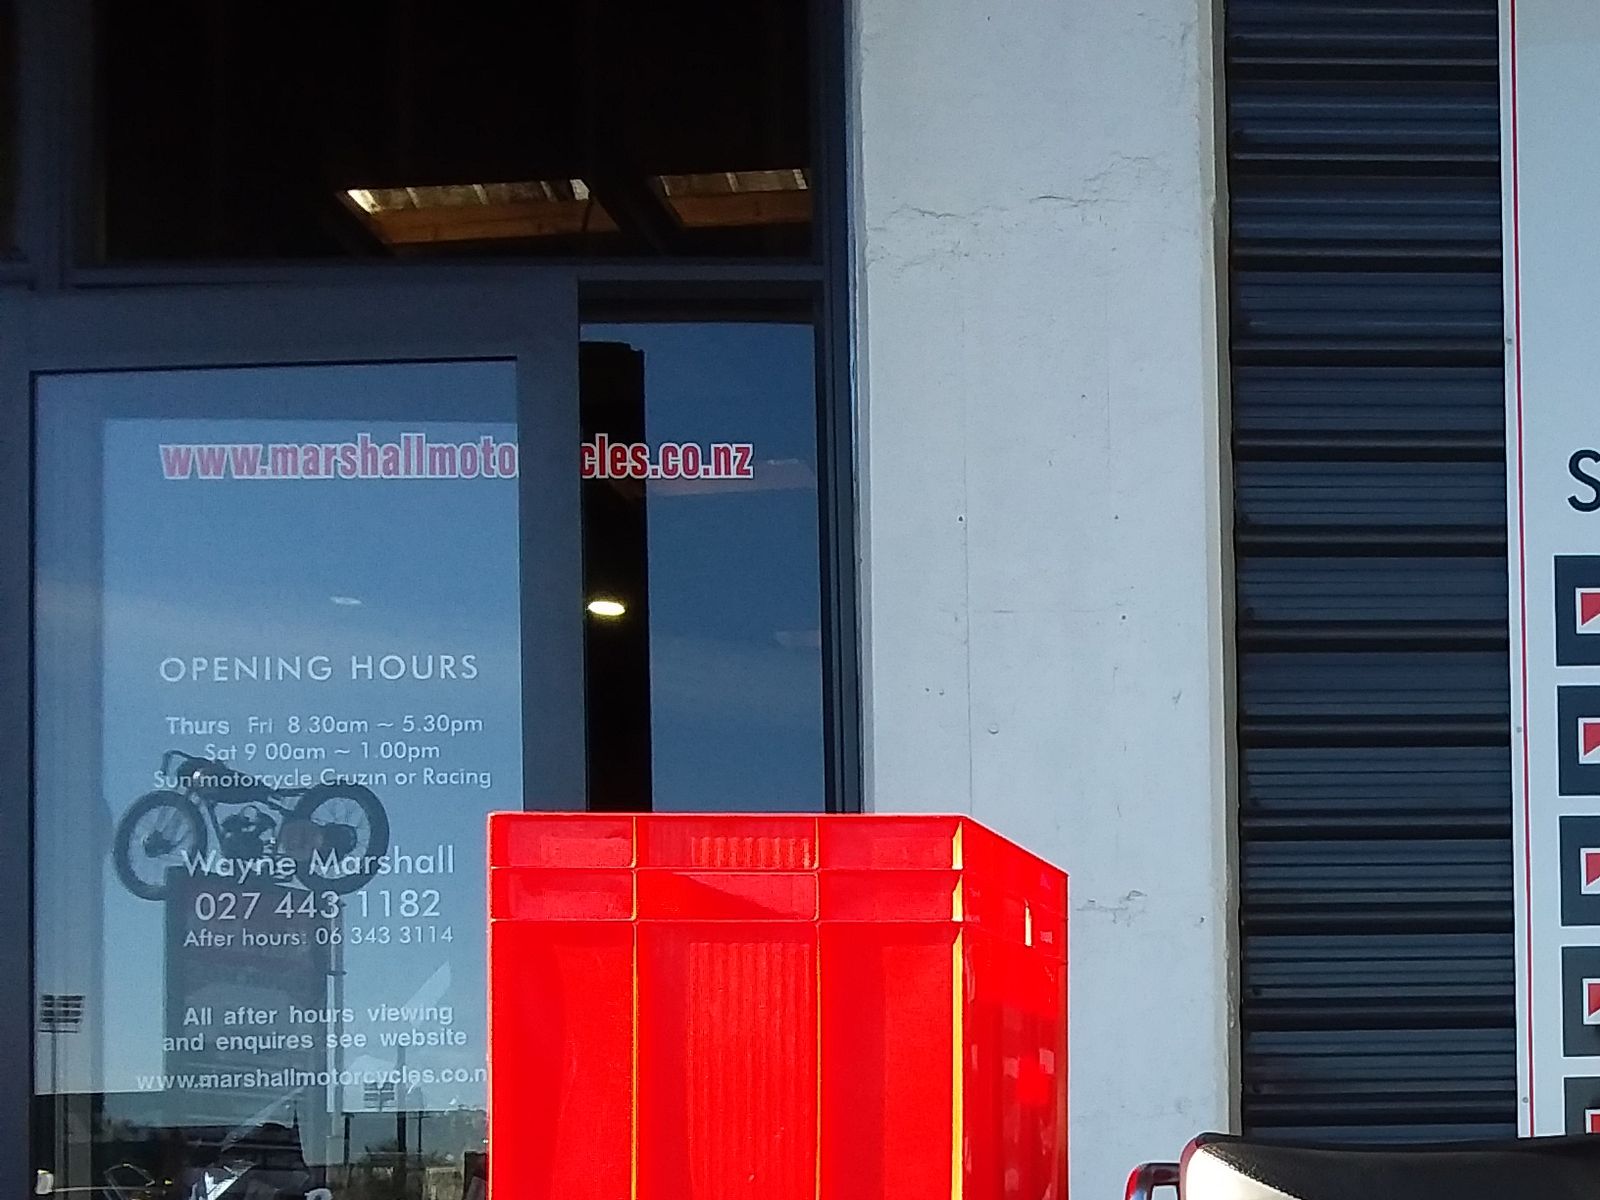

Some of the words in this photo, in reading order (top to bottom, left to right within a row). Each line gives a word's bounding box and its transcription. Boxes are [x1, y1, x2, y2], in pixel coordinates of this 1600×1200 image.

[159, 432, 753, 480] www.marshallmotocles.co.nz
[159, 655, 334, 683] OPENING
[351, 653, 479, 681] HOURS
[165, 715, 230, 735] Thurs
[248, 716, 273, 734] Fri
[402, 714, 483, 737] 5.30pm
[204, 743, 237, 761] Sat
[153, 770, 192, 788] Sun
[200, 768, 312, 791] motorcycle
[394, 772, 417, 786] or
[423, 767, 491, 789] Racing
[182, 850, 297, 887] Wayne
[309, 846, 455, 877] Marshall
[194, 892, 261, 921] 027
[275, 891, 341, 920] 443
[358, 889, 441, 918] 1182
[183, 928, 234, 948] After
[315, 927, 342, 945] 06
[350, 926, 391, 945] 343
[399, 925, 454, 944] 3114
[183, 1007, 212, 1027] All
[224, 1006, 278, 1027] after
[289, 1005, 354, 1025] hours
[367, 1003, 455, 1026] viewing
[163, 1032, 204, 1052] and
[216, 1030, 314, 1054] enquires
[326, 1032, 367, 1049] see
[380, 1028, 467, 1048] website
[136, 1065, 487, 1090] www.marshallmotorcycles.co.n
